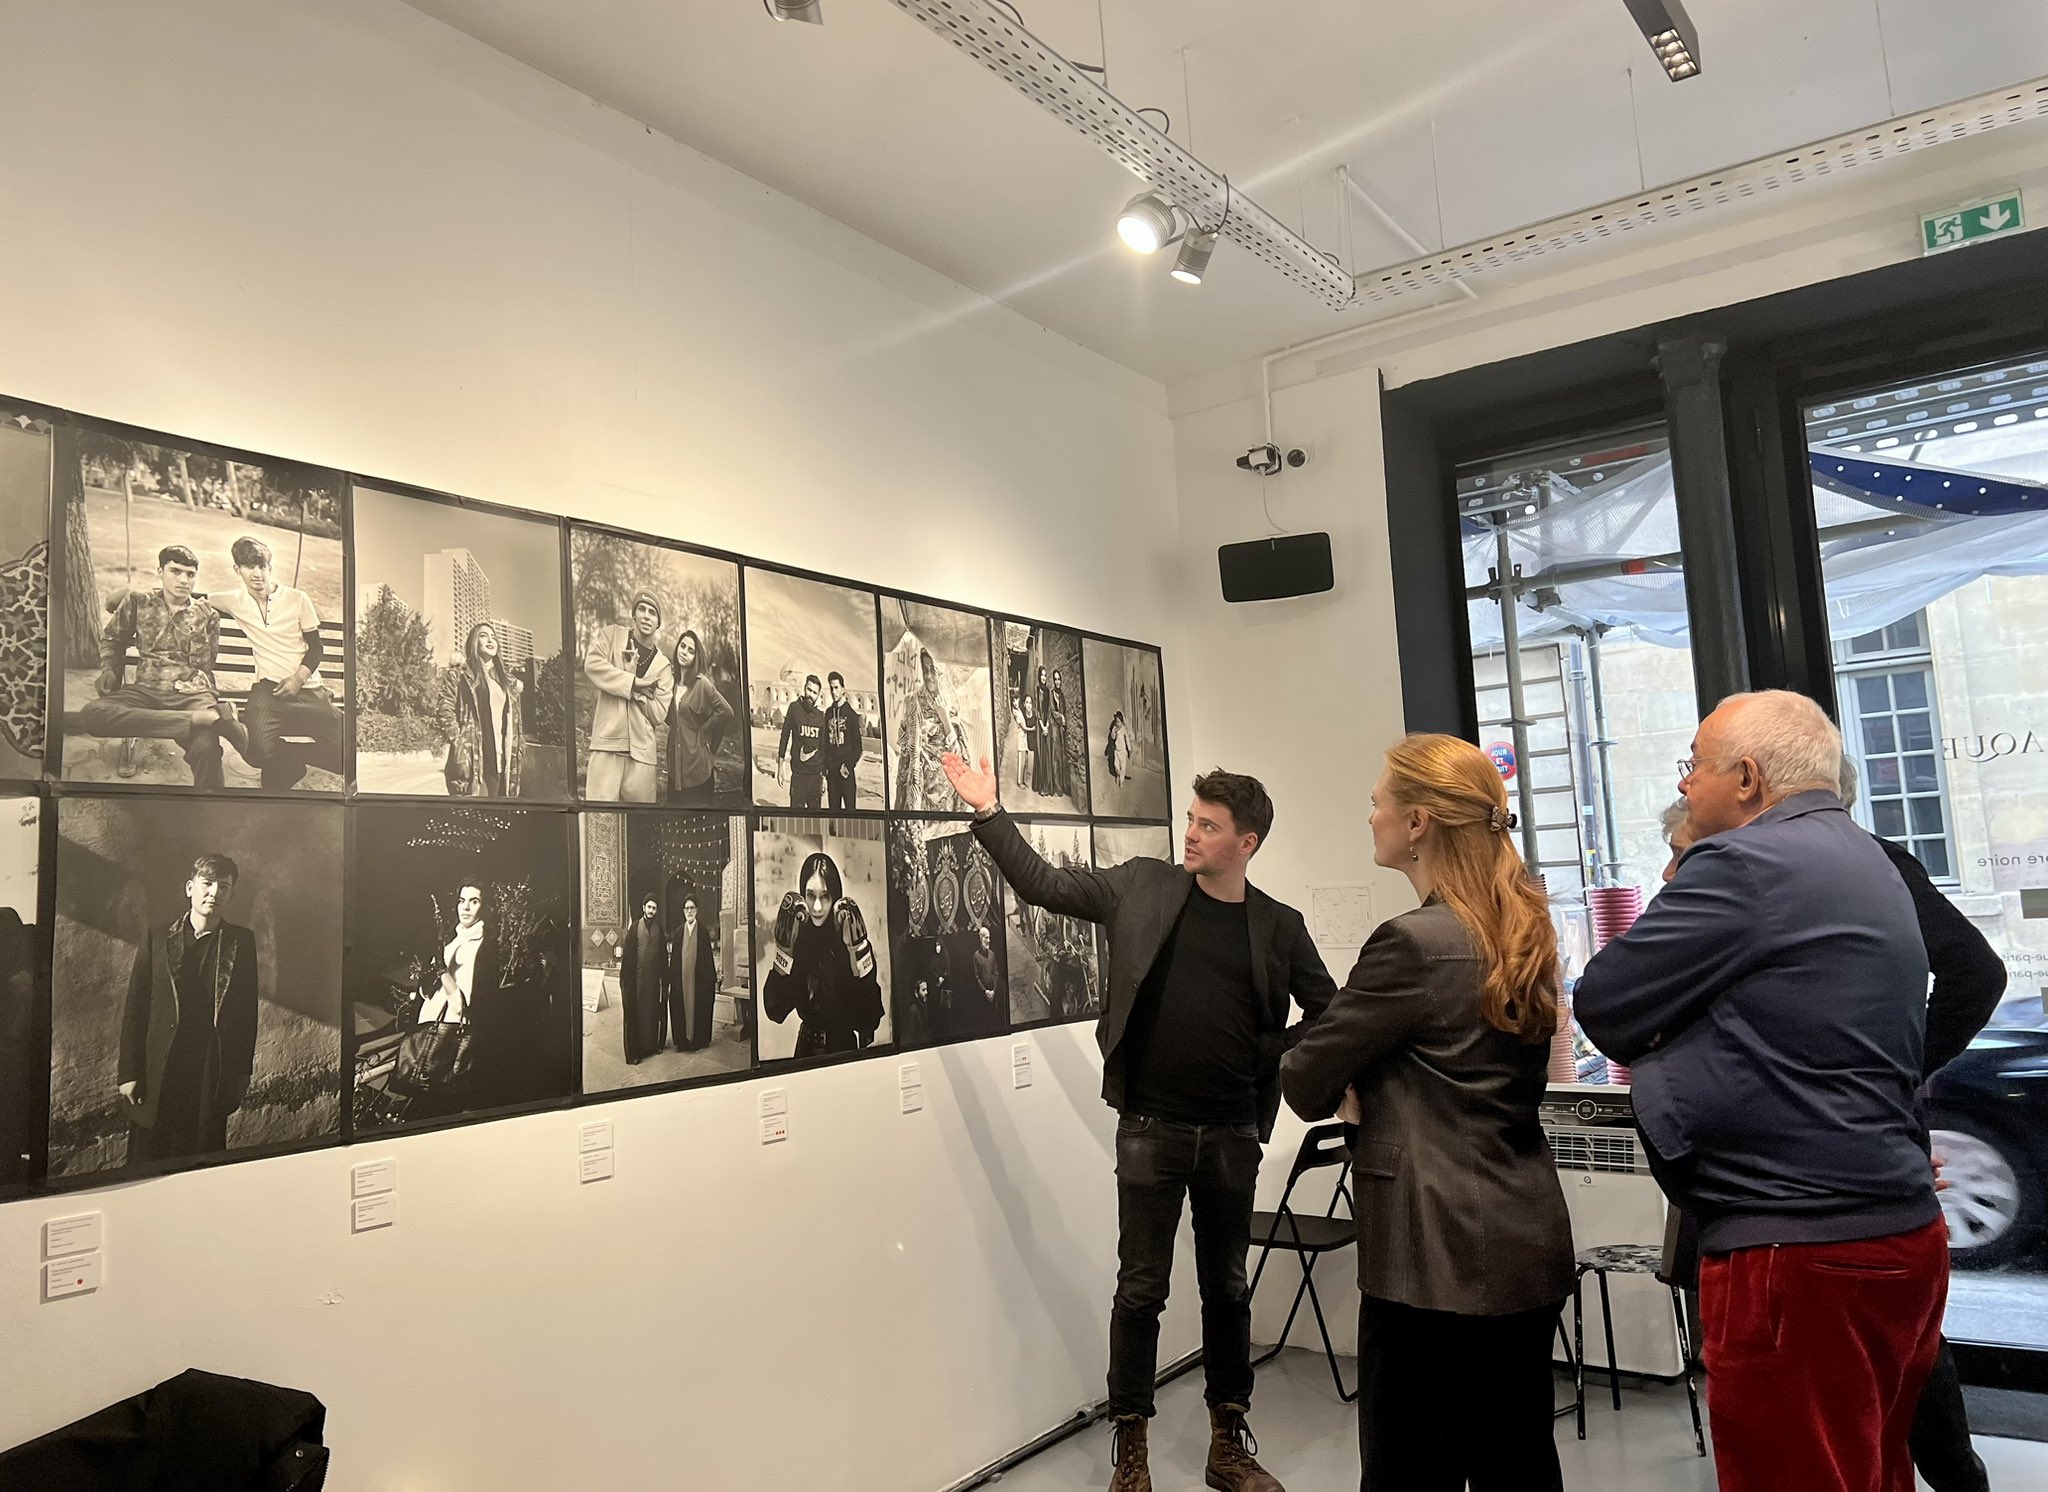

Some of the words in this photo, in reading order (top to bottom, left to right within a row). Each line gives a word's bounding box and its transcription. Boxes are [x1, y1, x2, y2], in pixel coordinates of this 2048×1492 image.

[800, 725, 820, 738] JUST
[1491, 749, 1508, 757] JOUR
[1496, 765, 1508, 773] UIT
